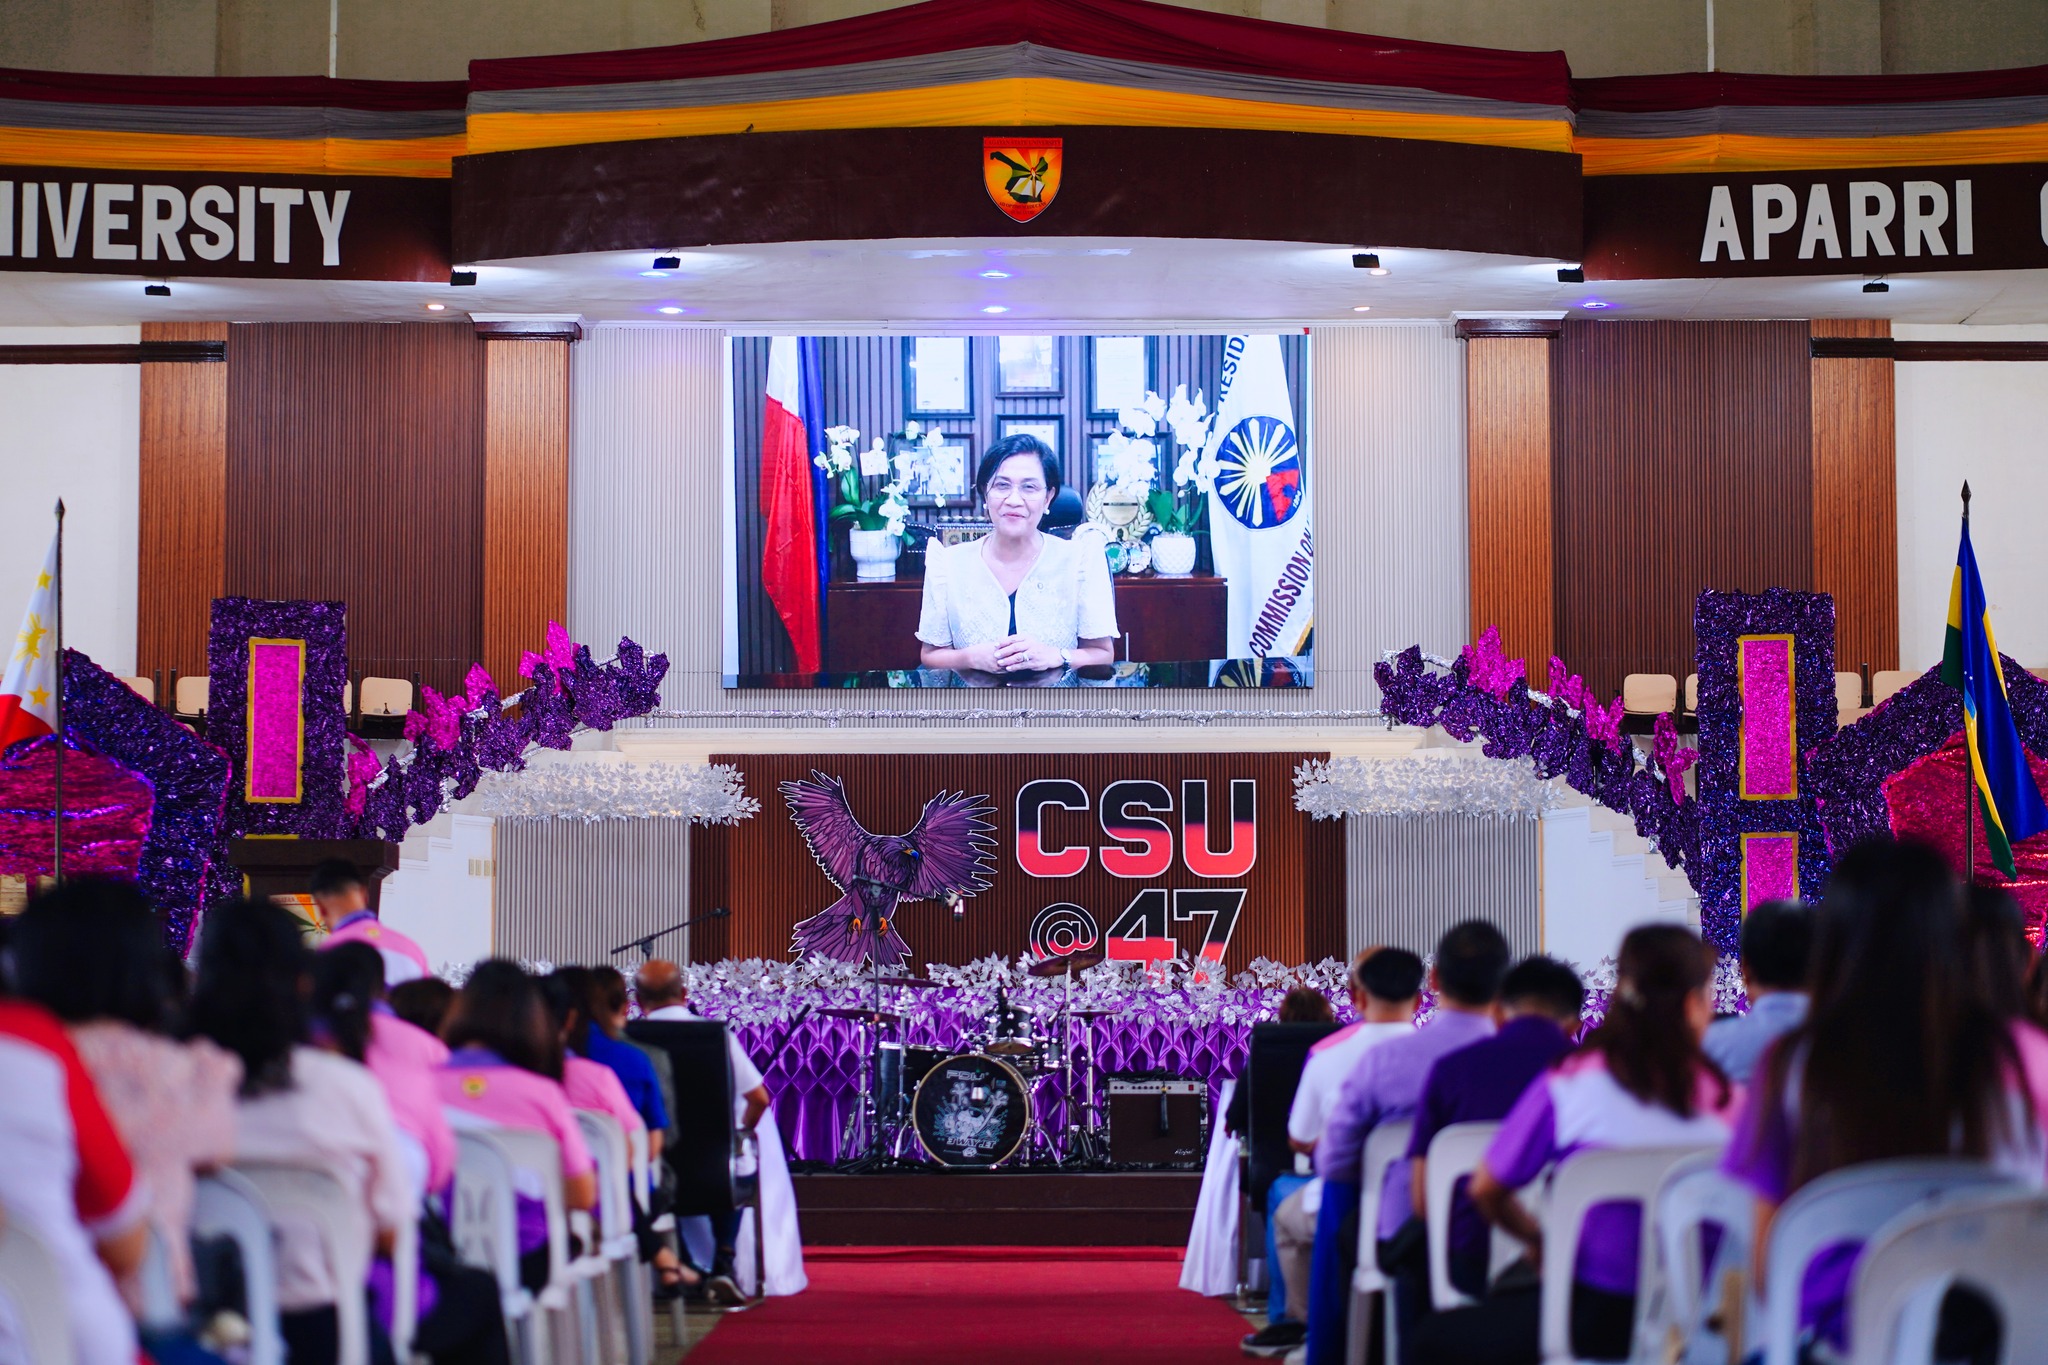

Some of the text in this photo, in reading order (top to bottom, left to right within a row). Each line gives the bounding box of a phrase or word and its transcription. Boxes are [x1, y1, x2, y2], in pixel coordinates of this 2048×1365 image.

[1700, 179, 1974, 262] APARRI
[1217, 335, 1249, 415] ESID
[1249, 551, 1312, 659] COMMISSION
[1016, 779, 1257, 879] CSU
